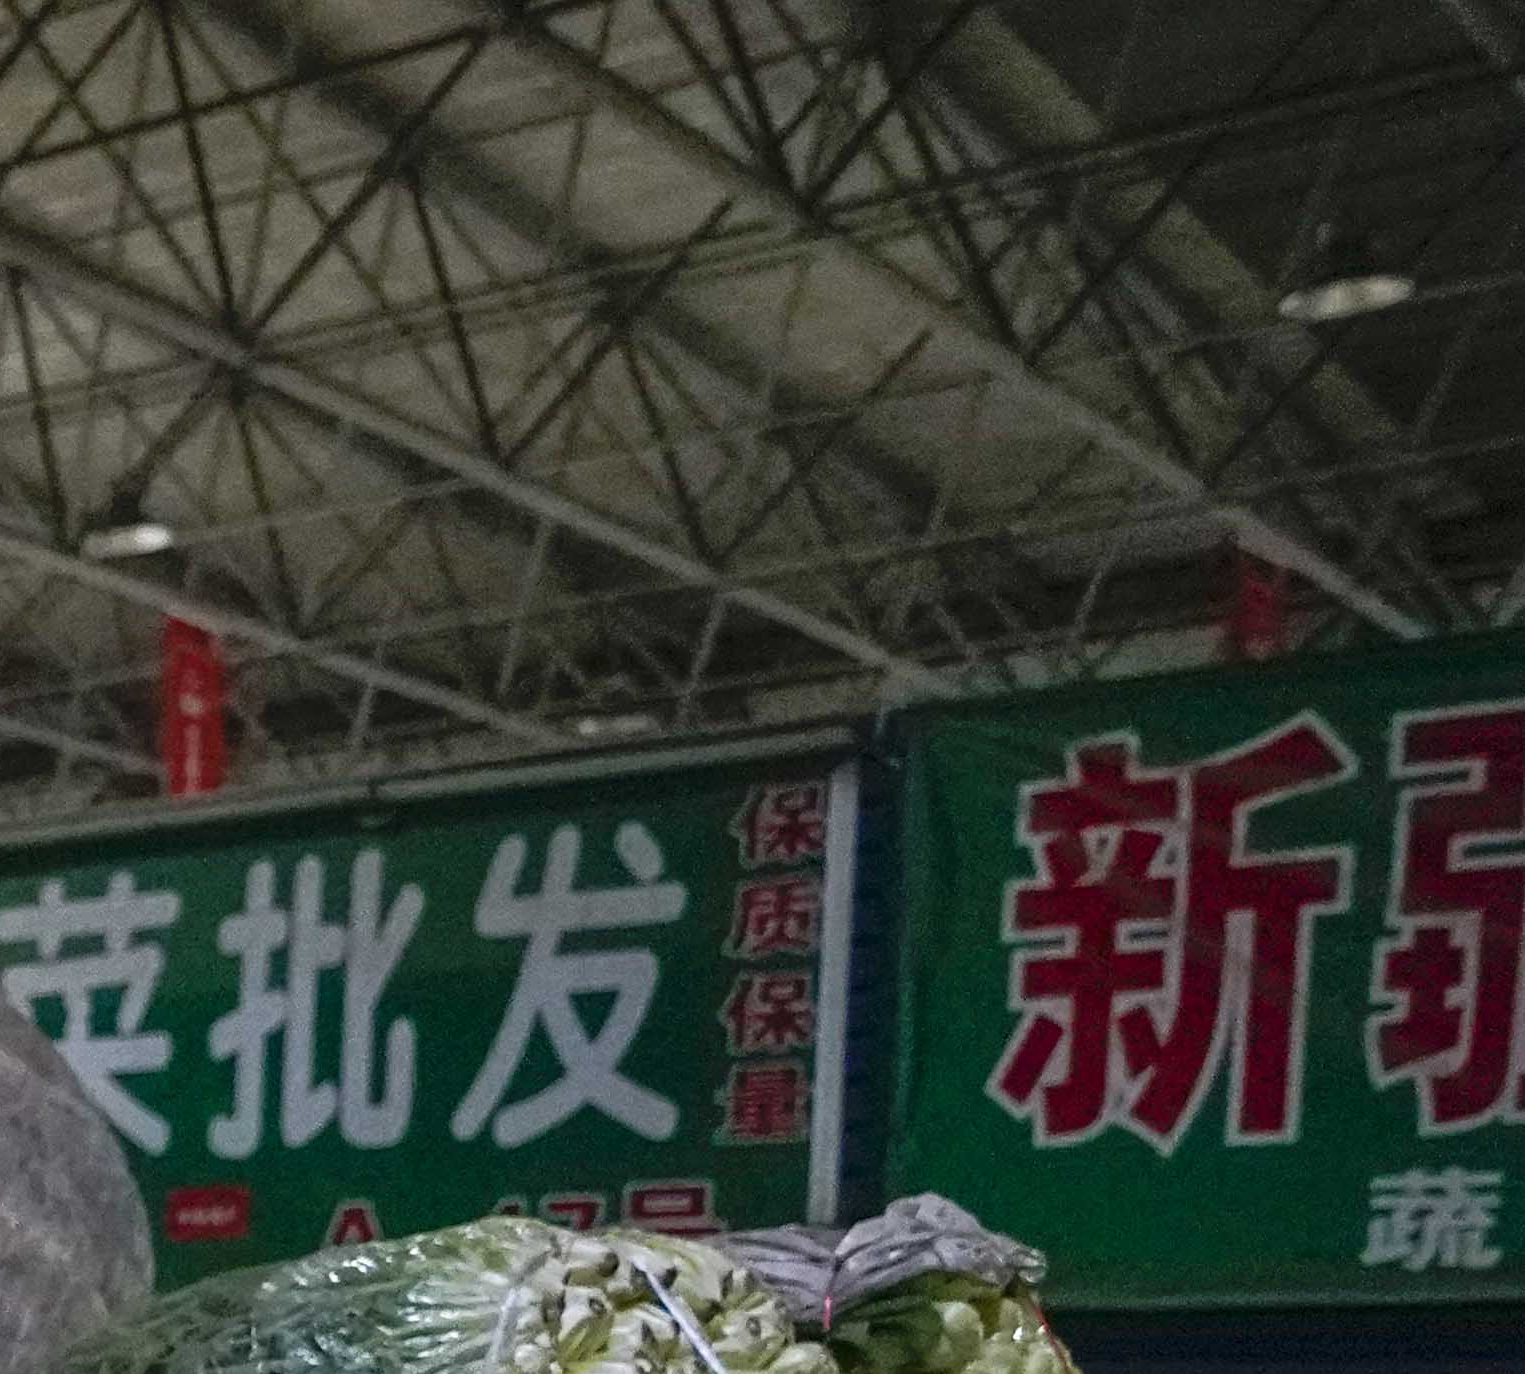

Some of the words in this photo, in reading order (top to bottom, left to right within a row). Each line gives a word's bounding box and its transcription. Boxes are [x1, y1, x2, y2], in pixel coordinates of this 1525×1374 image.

[716, 782, 827, 1143] 保质保量
[1360, 1164, 1505, 1271] 蔬
